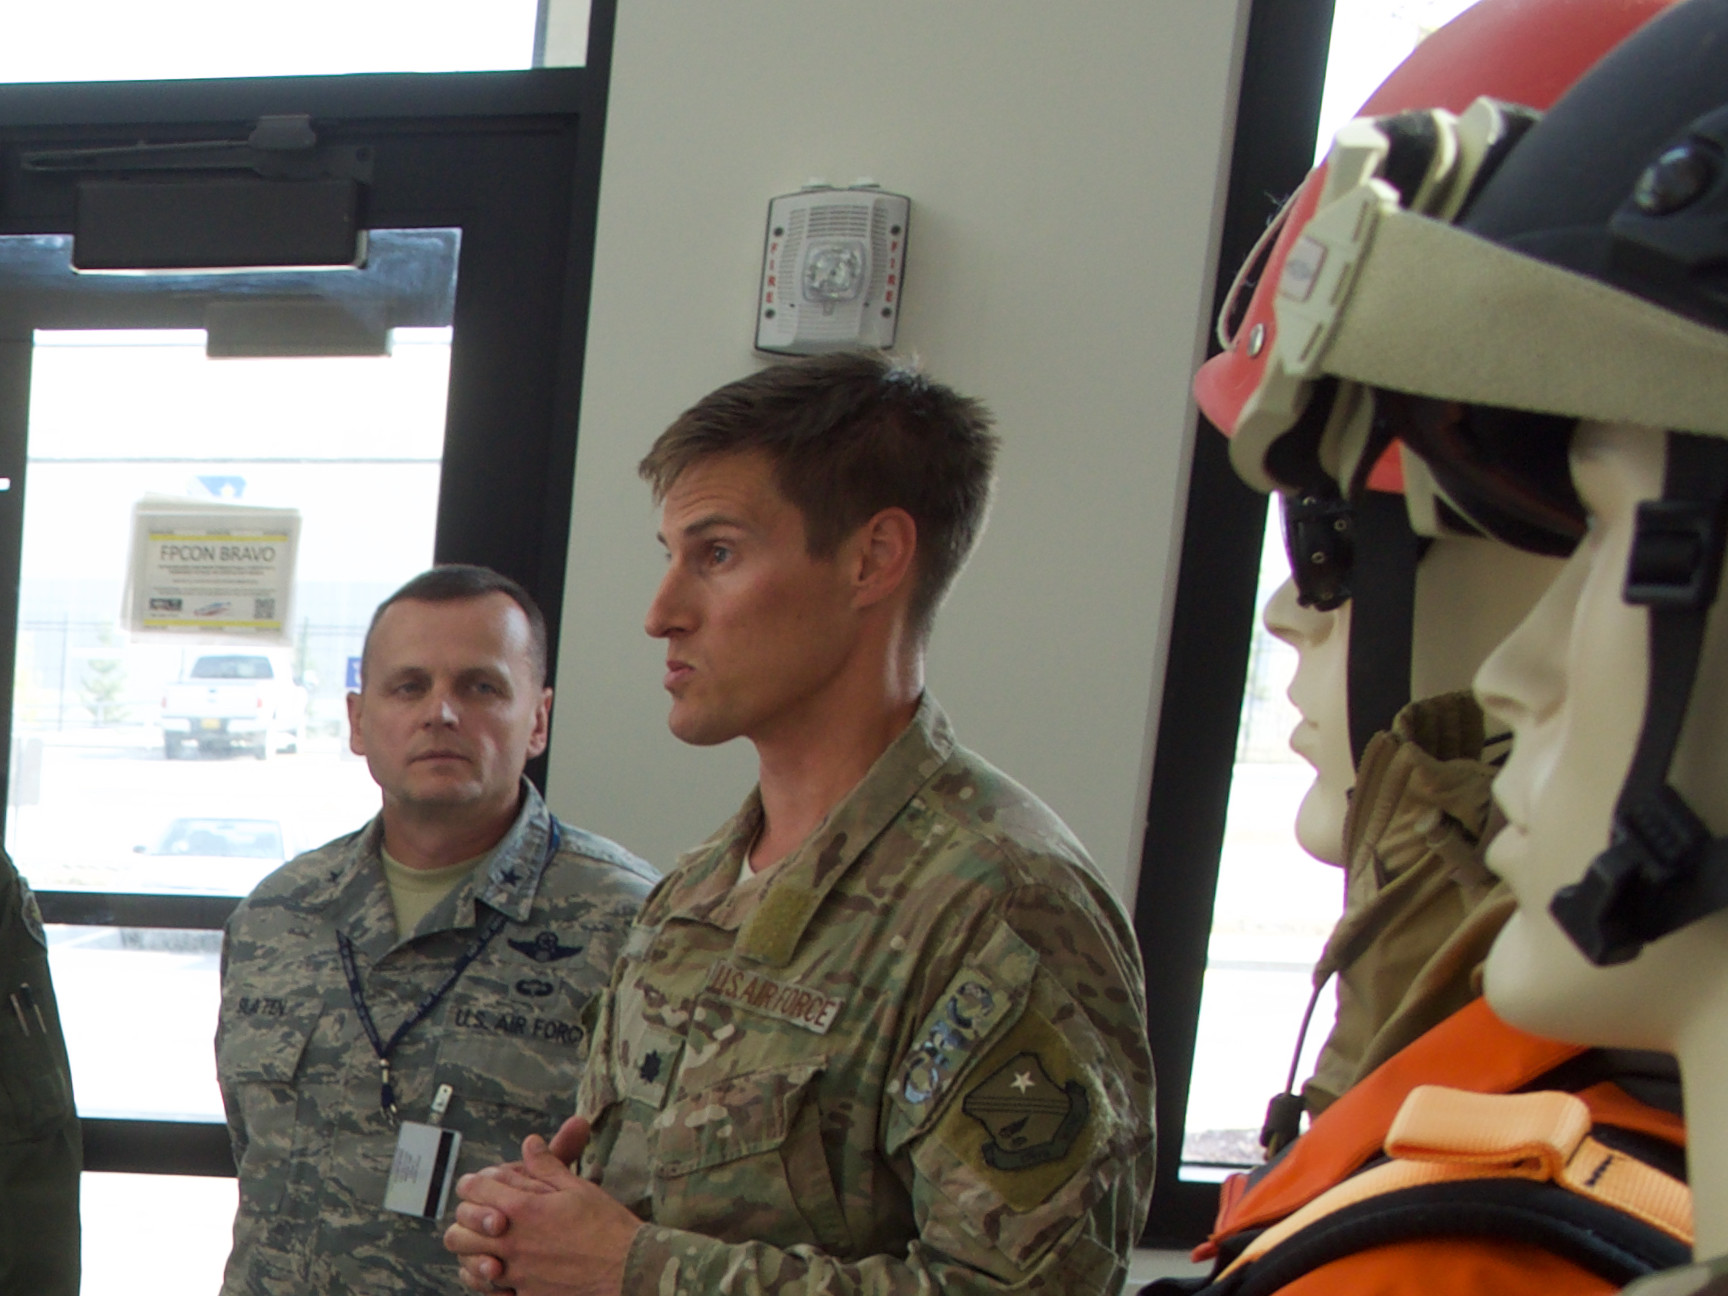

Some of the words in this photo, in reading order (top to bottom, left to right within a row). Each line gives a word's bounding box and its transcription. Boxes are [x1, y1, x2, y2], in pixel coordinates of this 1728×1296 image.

[765, 242, 778, 304] FIRE
[885, 240, 898, 302] FIRE
[160, 545, 215, 561] FPCON
[219, 546, 276, 562] BRAVO
[741, 976, 779, 1009] AIR
[768, 985, 836, 1027] FORCE
[495, 1012, 526, 1035] AIR
[532, 1018, 584, 1043] FORC
